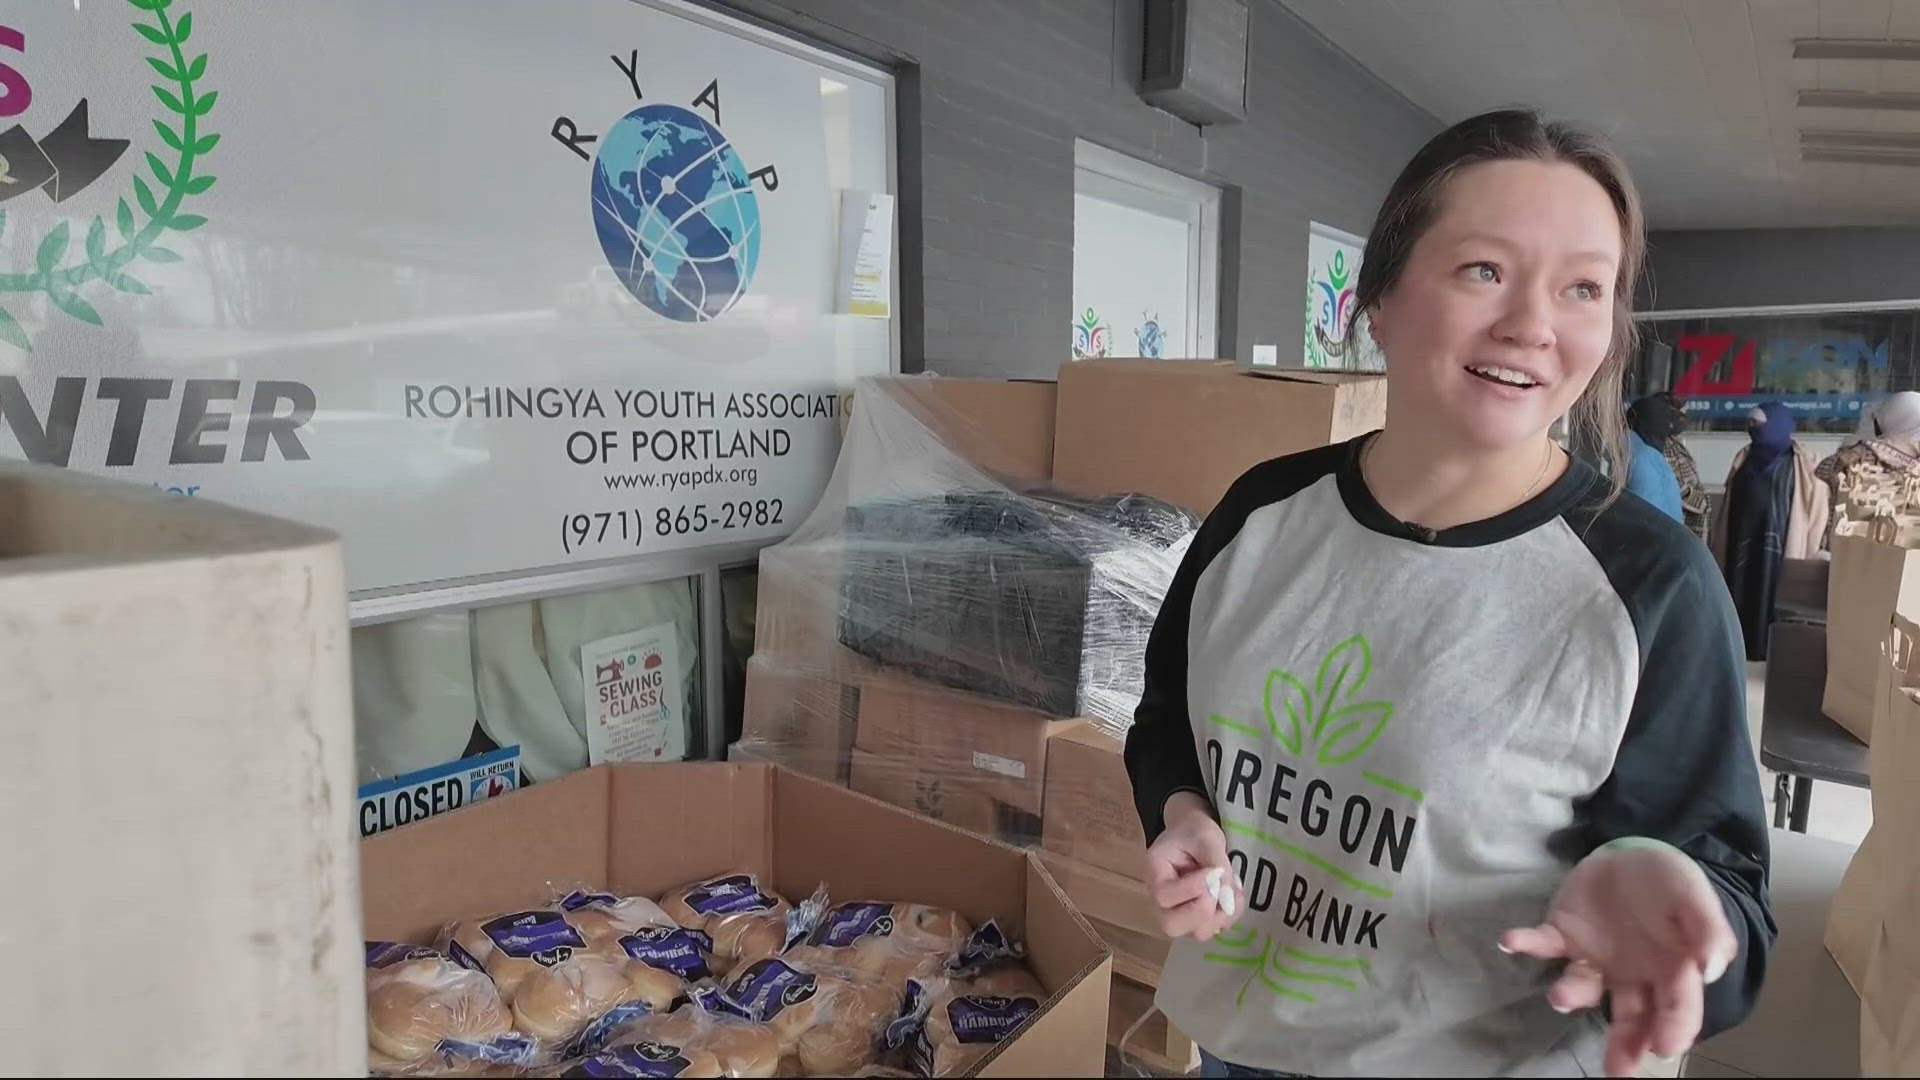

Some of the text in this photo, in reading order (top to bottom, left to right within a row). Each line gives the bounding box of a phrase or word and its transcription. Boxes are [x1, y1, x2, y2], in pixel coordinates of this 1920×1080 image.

[404, 384, 605, 420] ROHINGYA
[614, 389, 715, 419] YOUTH
[566, 428, 791, 465] OF PORTLAND
[604, 464, 758, 491] www.ryapdx.org
[561, 498, 783, 554] (971) 865-2982
[600, 671, 662, 703] SEWING
[609, 690, 657, 718] CLASS
[469, 767, 486, 780] WILL
[359, 776, 464, 838] CLOSED
[1283, 871, 1388, 949] BANK
